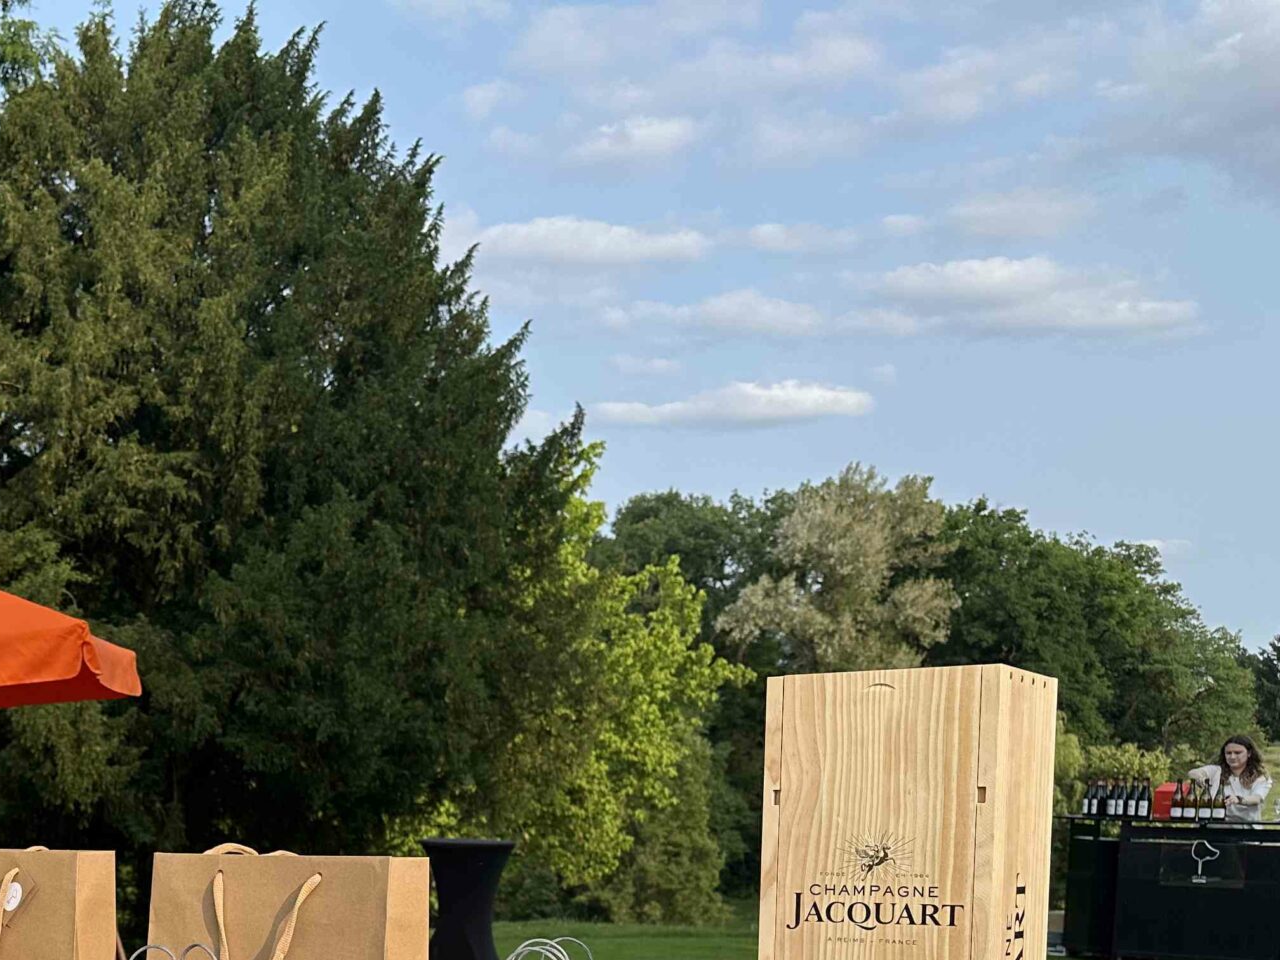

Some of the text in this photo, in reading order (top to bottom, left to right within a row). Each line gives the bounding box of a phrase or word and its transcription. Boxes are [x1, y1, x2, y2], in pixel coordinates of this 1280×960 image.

[809, 883, 940, 898] CHAMPAGNE
[786, 892, 965, 931] JACQUART
[878, 938, 918, 946] FRANCE
